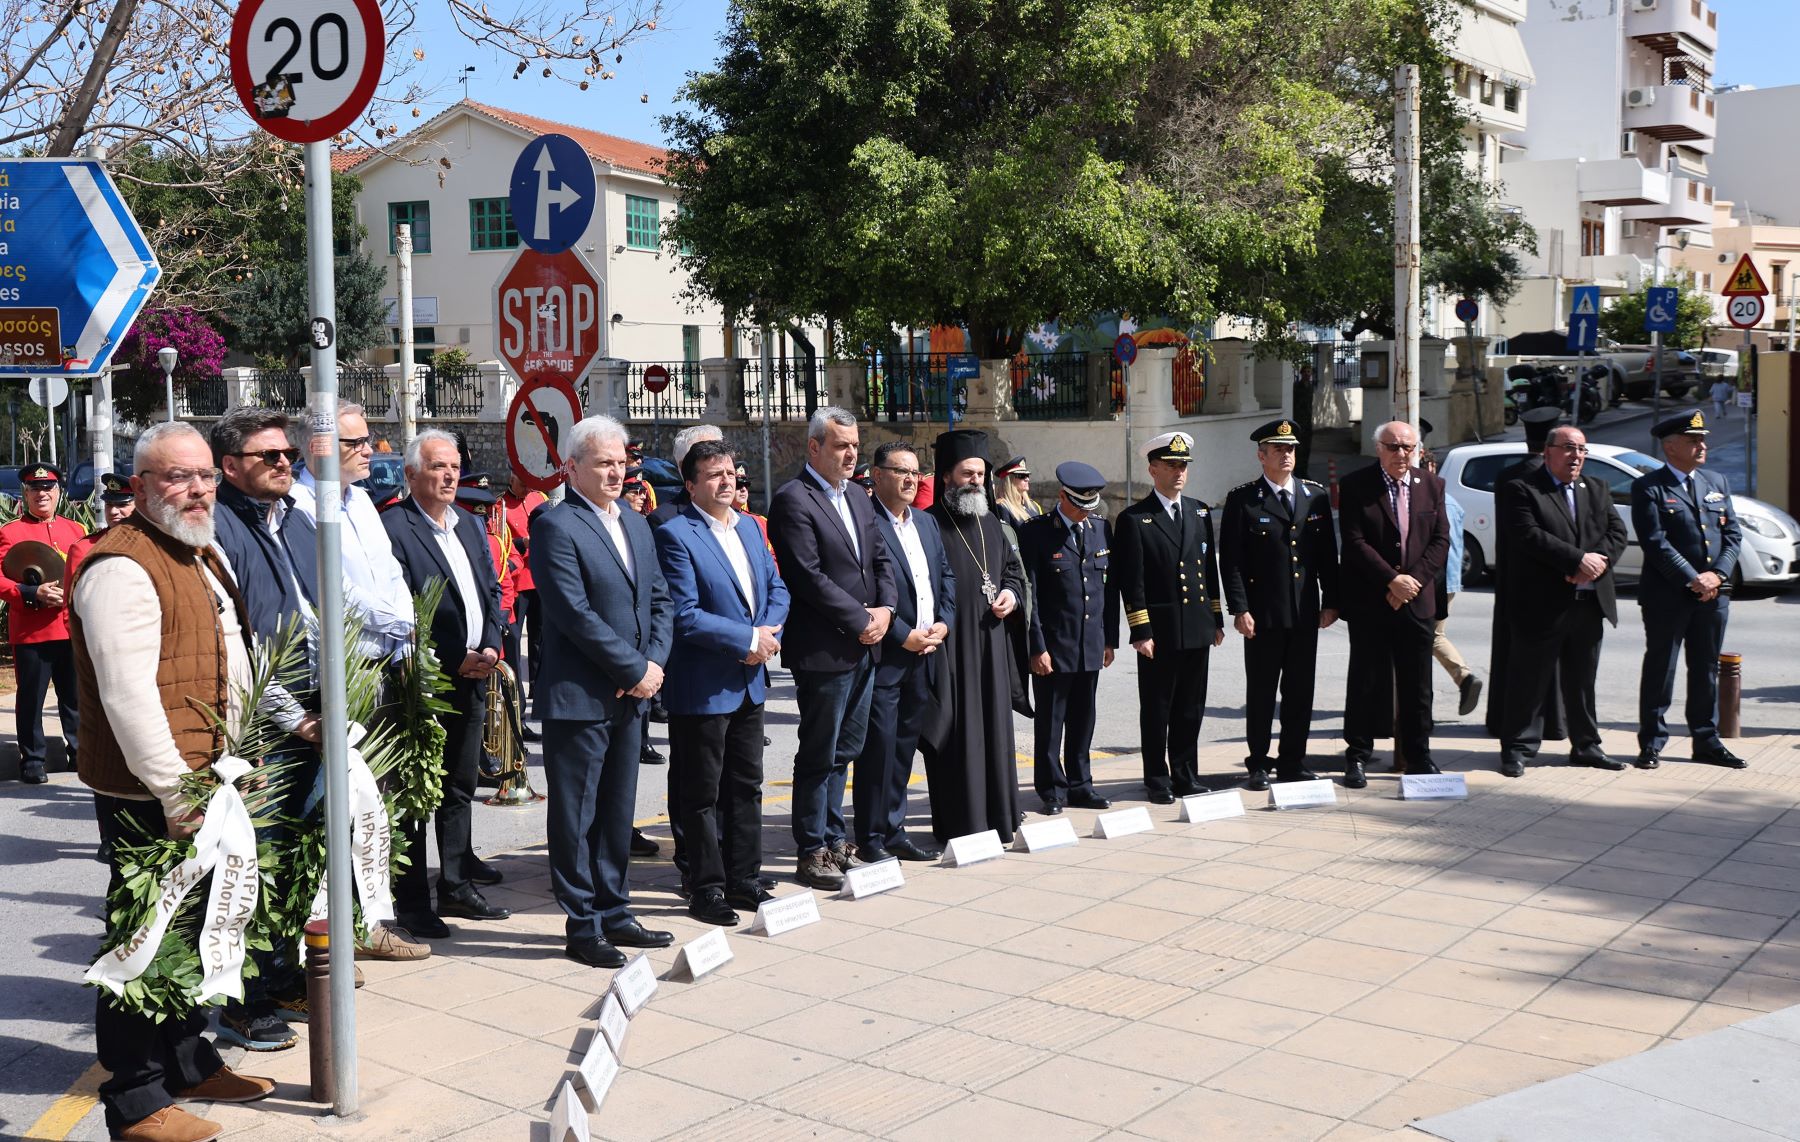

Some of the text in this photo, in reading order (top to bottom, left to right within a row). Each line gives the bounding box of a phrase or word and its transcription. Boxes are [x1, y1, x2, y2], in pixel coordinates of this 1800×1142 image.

[264, 12, 349, 84] 20
[0, 192, 20, 209] ia
[503, 284, 594, 358] STOP
[1734, 301, 1756, 316] 20
[162, 864, 204, 913] ΛΥΣΗ
[361, 811, 376, 899] ΗΡΑΚΛΕΙΟΥ
[208, 854, 244, 978] ΒΕΛΟΠΟΥΛΟΣ
[229, 857, 257, 960] ΚΥΡΙΑΚΟΣ
